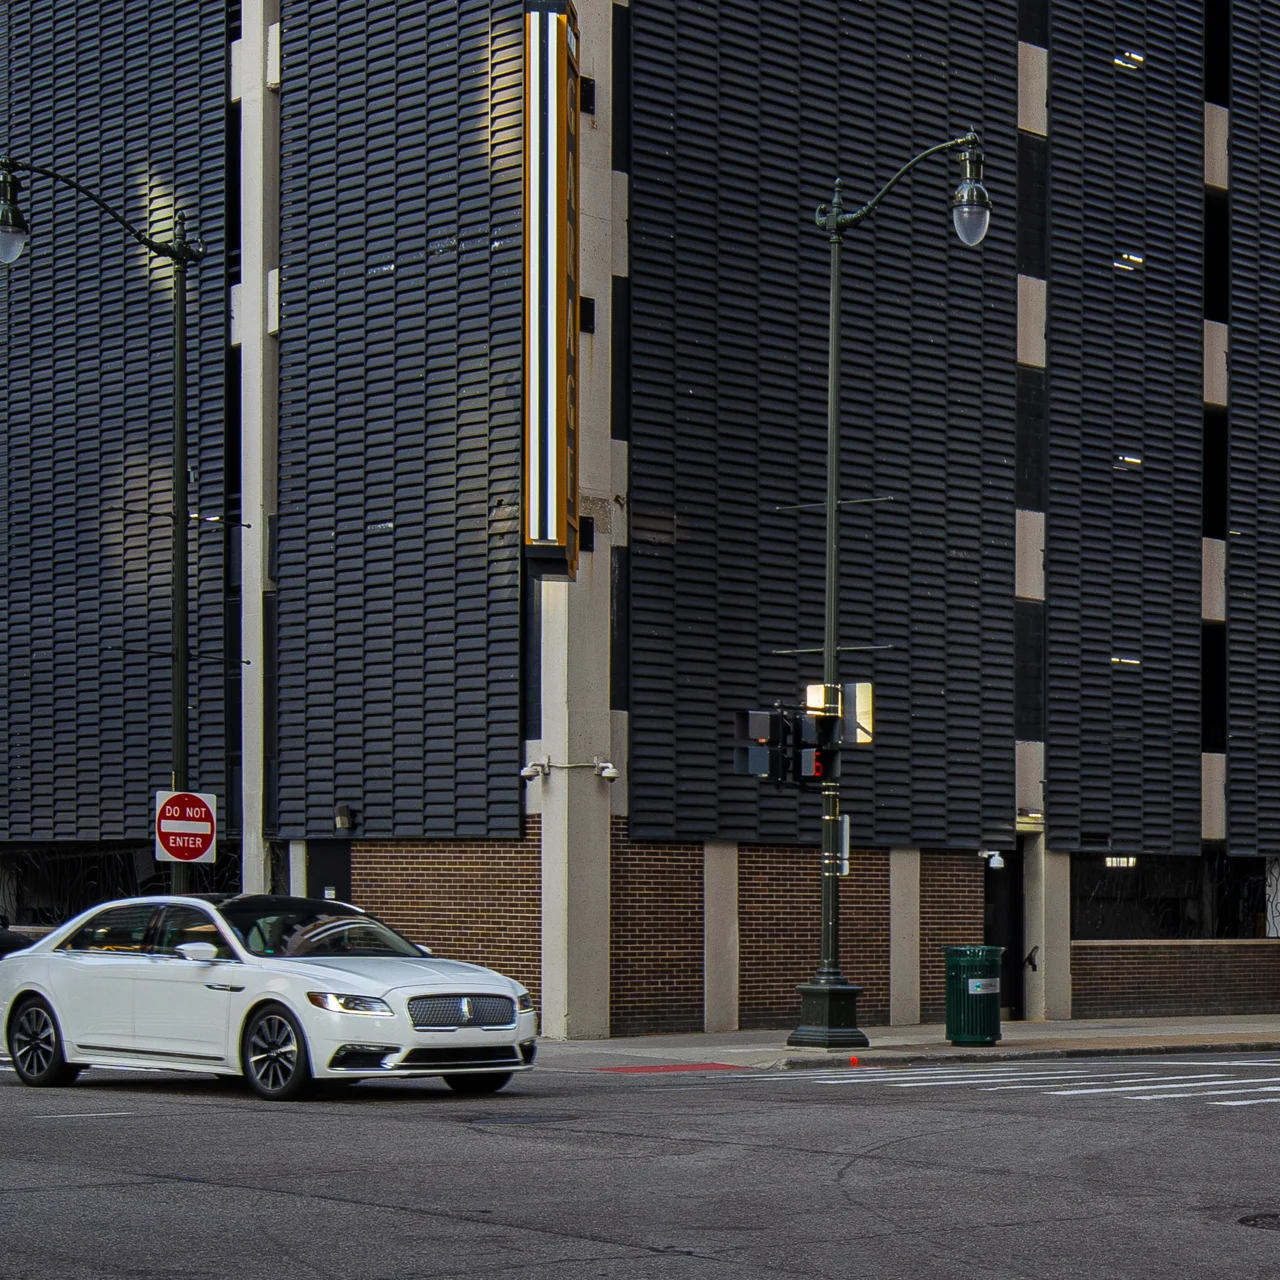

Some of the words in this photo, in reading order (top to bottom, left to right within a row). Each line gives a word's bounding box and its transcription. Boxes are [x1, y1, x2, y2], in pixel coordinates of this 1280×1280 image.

[165, 805, 180, 817] DO
[186, 807, 206, 818] NOT
[169, 836, 202, 848] ENTER
